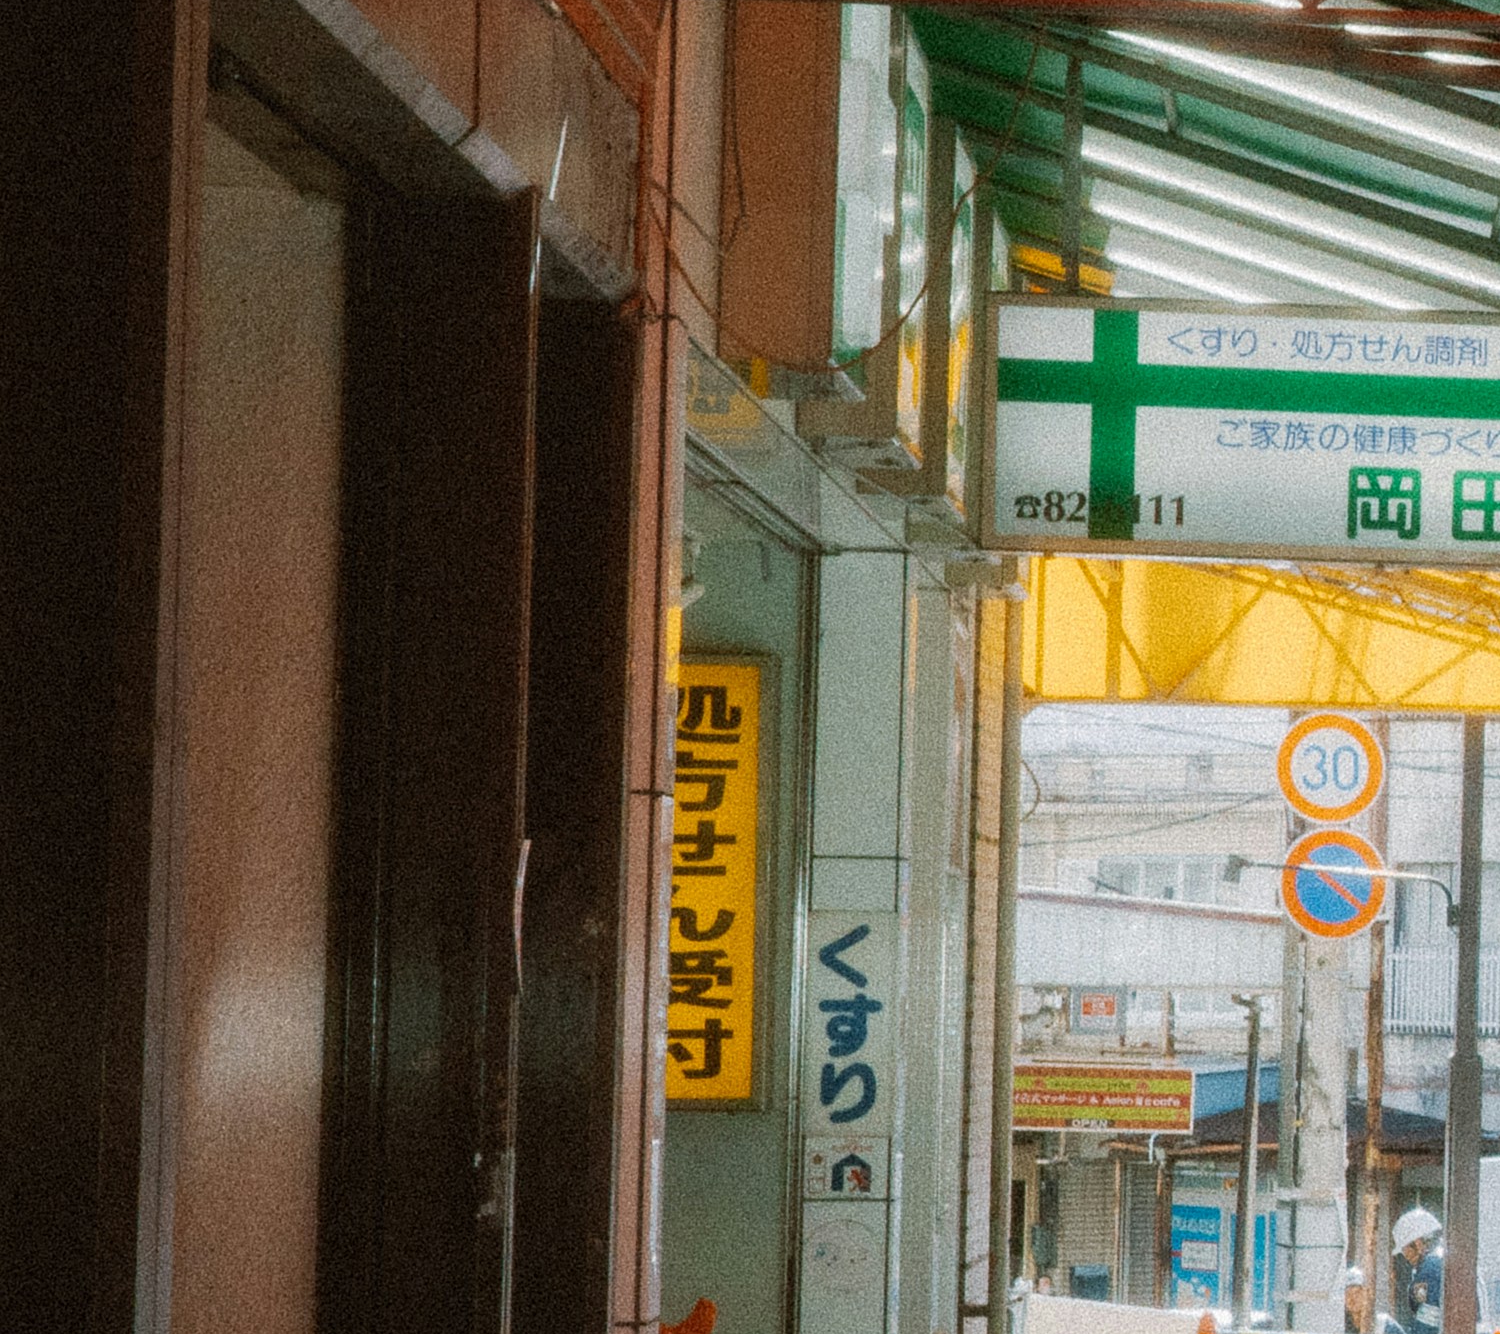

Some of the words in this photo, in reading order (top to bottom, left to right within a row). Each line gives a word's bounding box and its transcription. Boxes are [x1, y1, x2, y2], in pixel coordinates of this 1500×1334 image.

[1301, 744, 1360, 793] 30
[819, 923, 883, 1124] くすり
